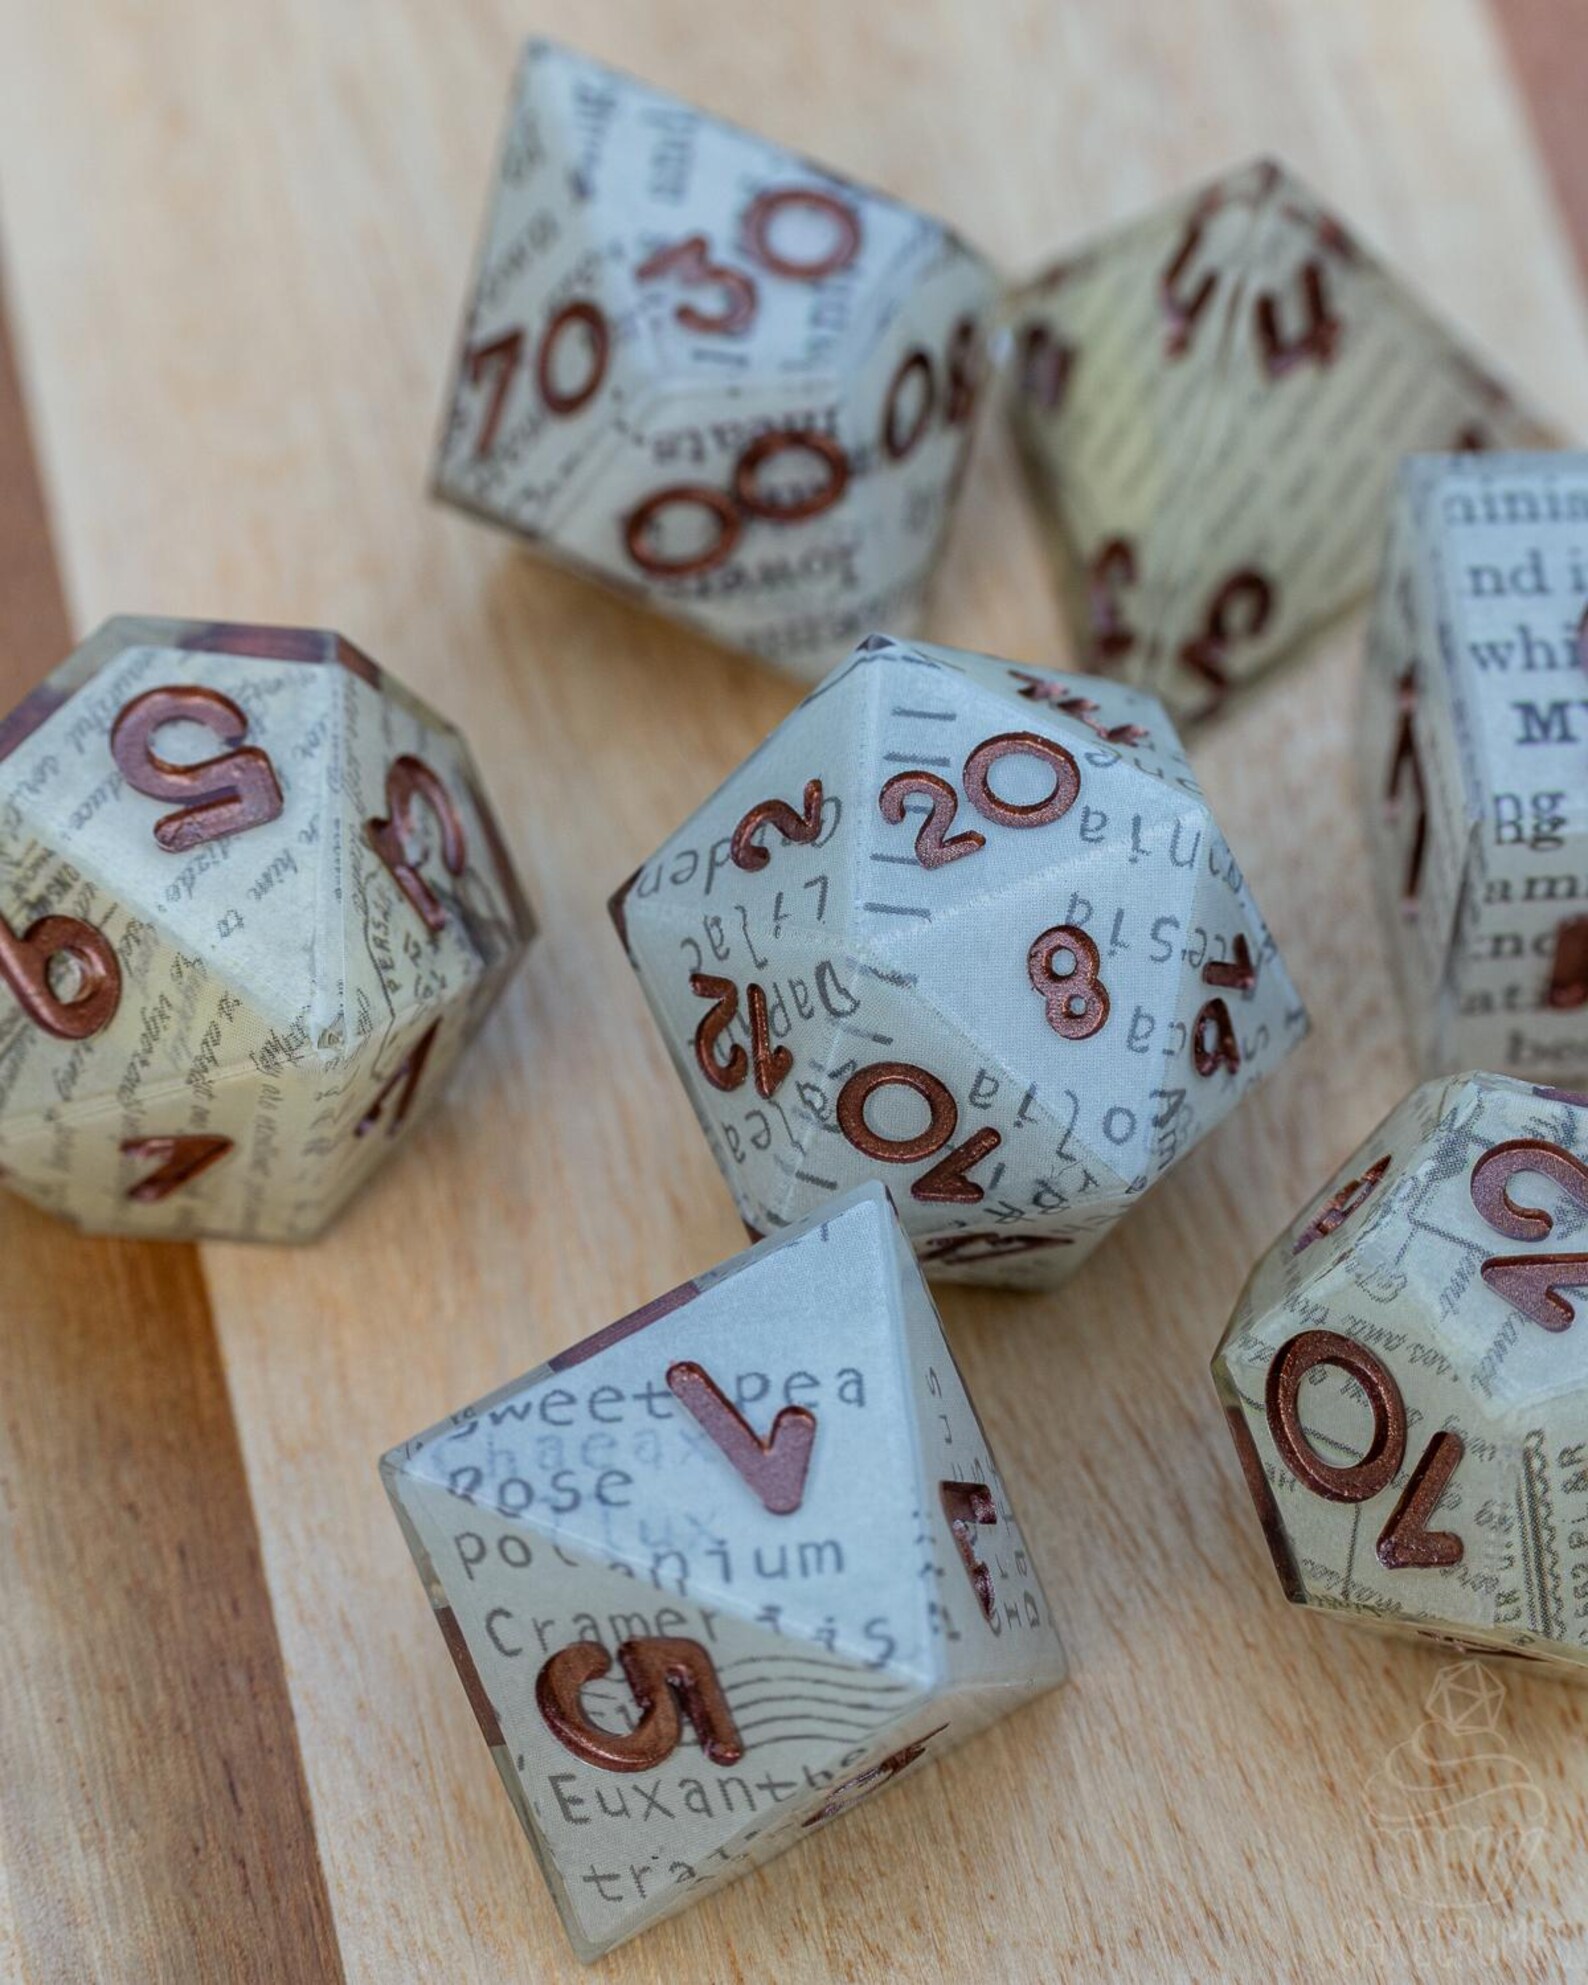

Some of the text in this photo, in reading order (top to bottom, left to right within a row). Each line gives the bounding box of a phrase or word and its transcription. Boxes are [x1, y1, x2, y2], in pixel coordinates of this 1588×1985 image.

[634, 186, 862, 333] 30
[466, 300, 612, 462] 70
[111, 684, 284, 854] 5
[730, 779, 823, 872] 2
[880, 730, 1081, 870] 20
[689, 971, 793, 1100] 12
[1028, 924, 1110, 1041] 8
[836, 1061, 1001, 1201] 10
[734, 1366, 868, 1412] pea
[1265, 1329, 1465, 1570] 10
[535, 1639, 745, 1774] 5
